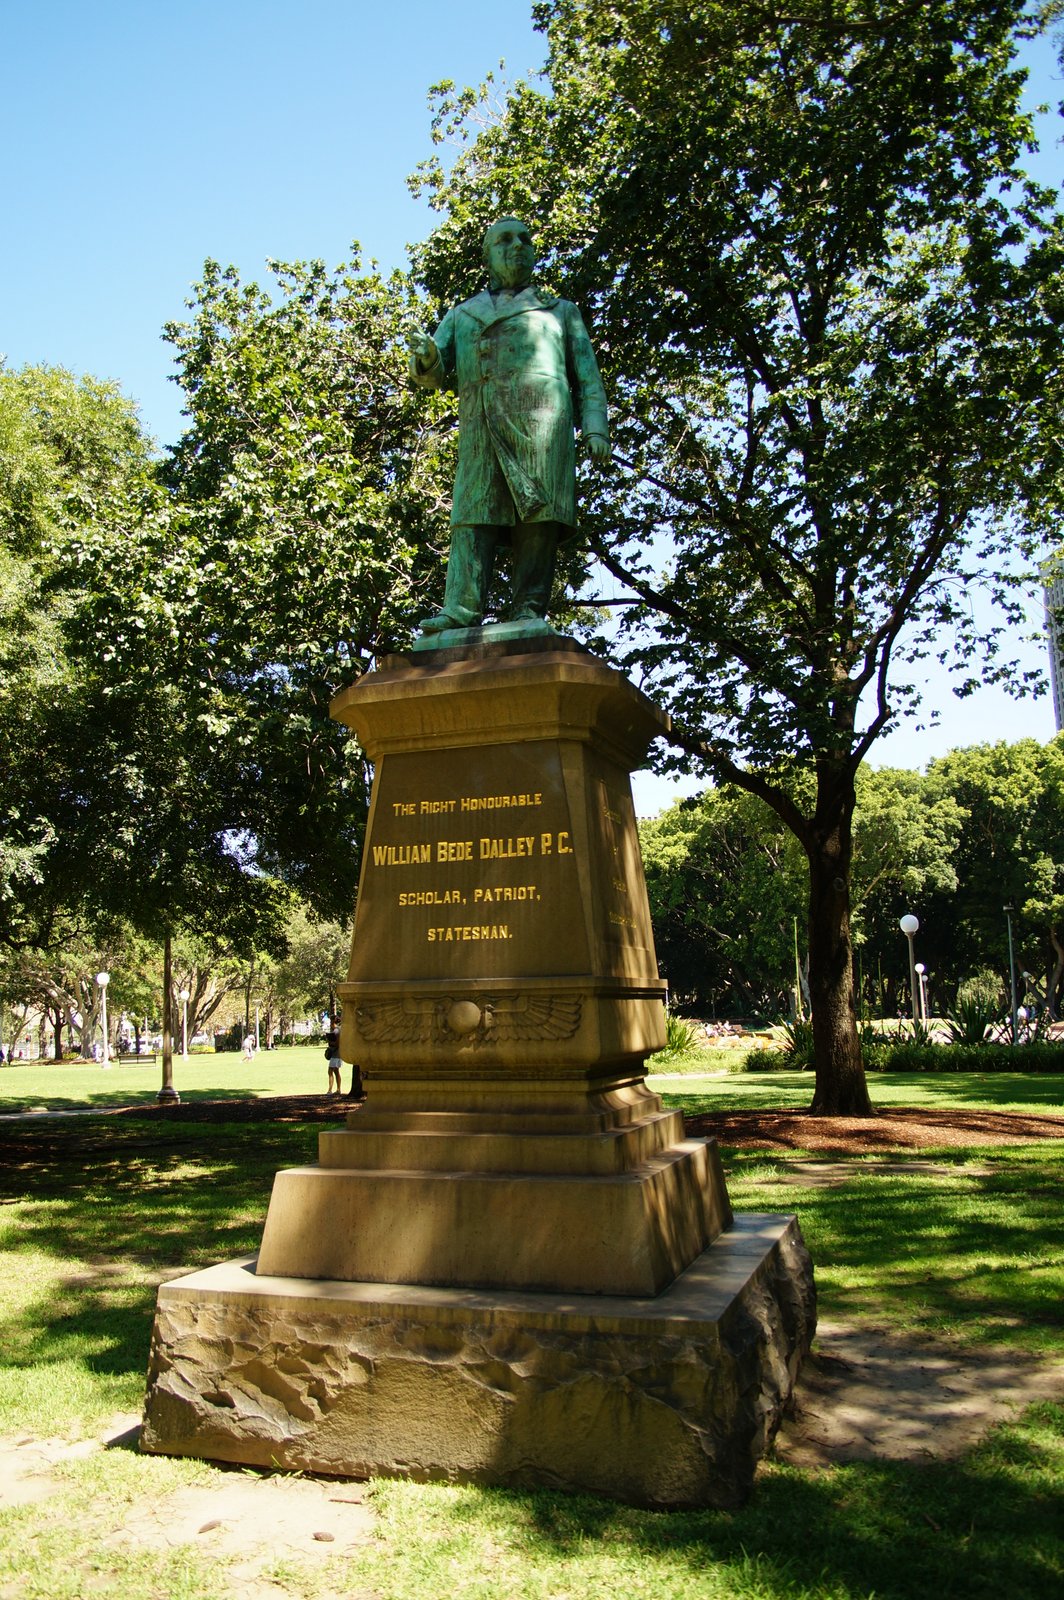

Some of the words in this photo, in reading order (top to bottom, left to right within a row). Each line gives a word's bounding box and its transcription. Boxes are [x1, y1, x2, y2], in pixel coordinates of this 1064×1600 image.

[393, 803, 415, 816] THE
[420, 800, 456, 814] RIGHT
[461, 793, 542, 811] HONOURABLE
[373, 844, 431, 866] WILLIAM
[437, 841, 473, 862] BEDE
[480, 836, 534, 859] DALLEY
[399, 890, 467, 906] SCHOLAR,
[474, 886, 540, 902] PATRIOT,
[428, 925, 512, 941] STATESMAN.
